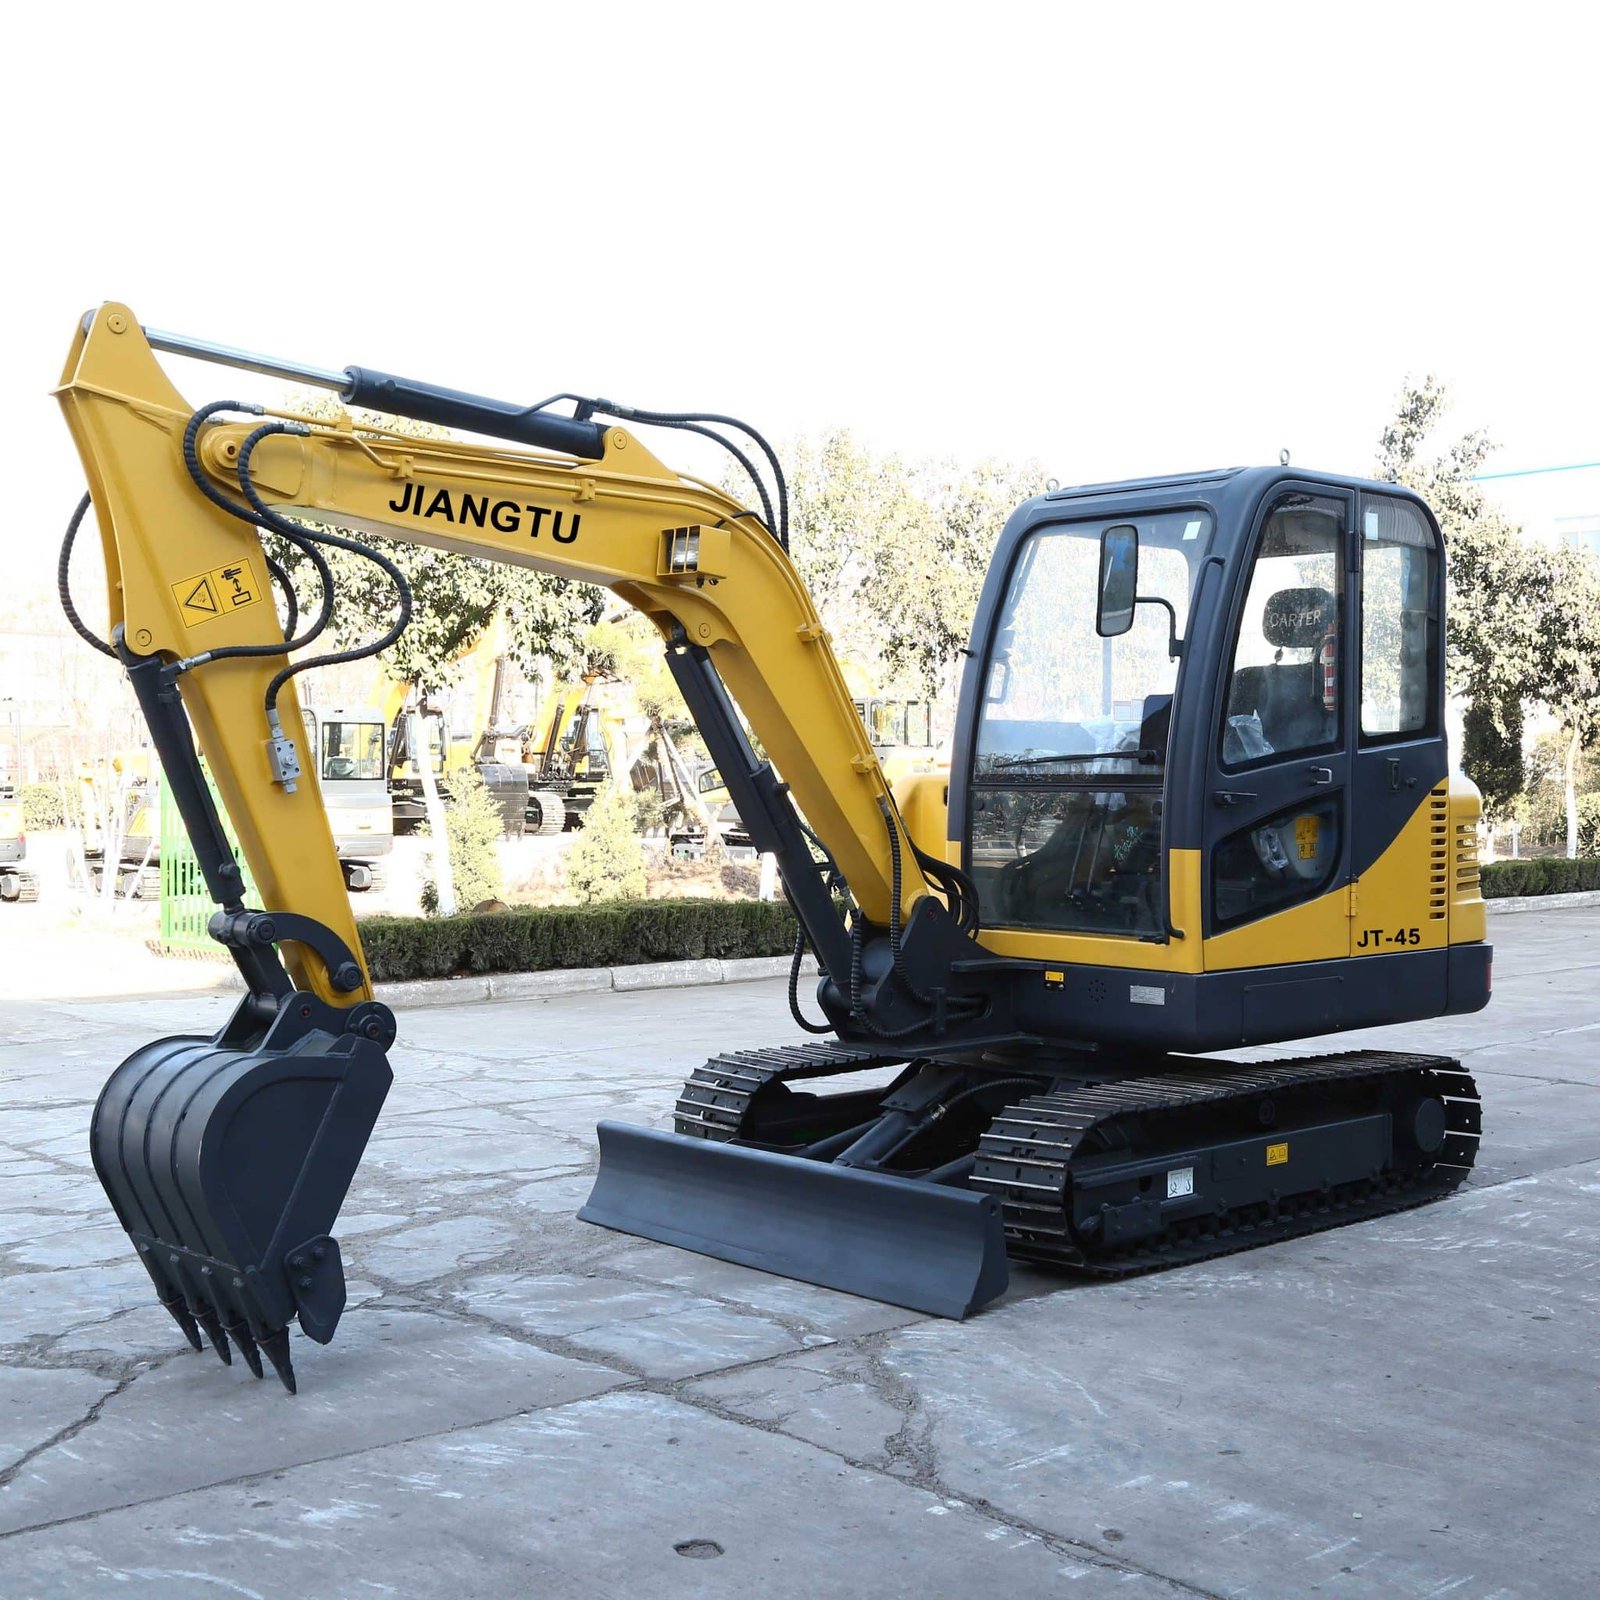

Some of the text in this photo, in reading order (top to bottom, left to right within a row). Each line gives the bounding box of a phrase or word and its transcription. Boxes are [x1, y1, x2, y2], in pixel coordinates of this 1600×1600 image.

[388, 482, 581, 544] JIANGTU
[1269, 609, 1322, 629] CARTER
[1356, 927, 1421, 948] JT-45
